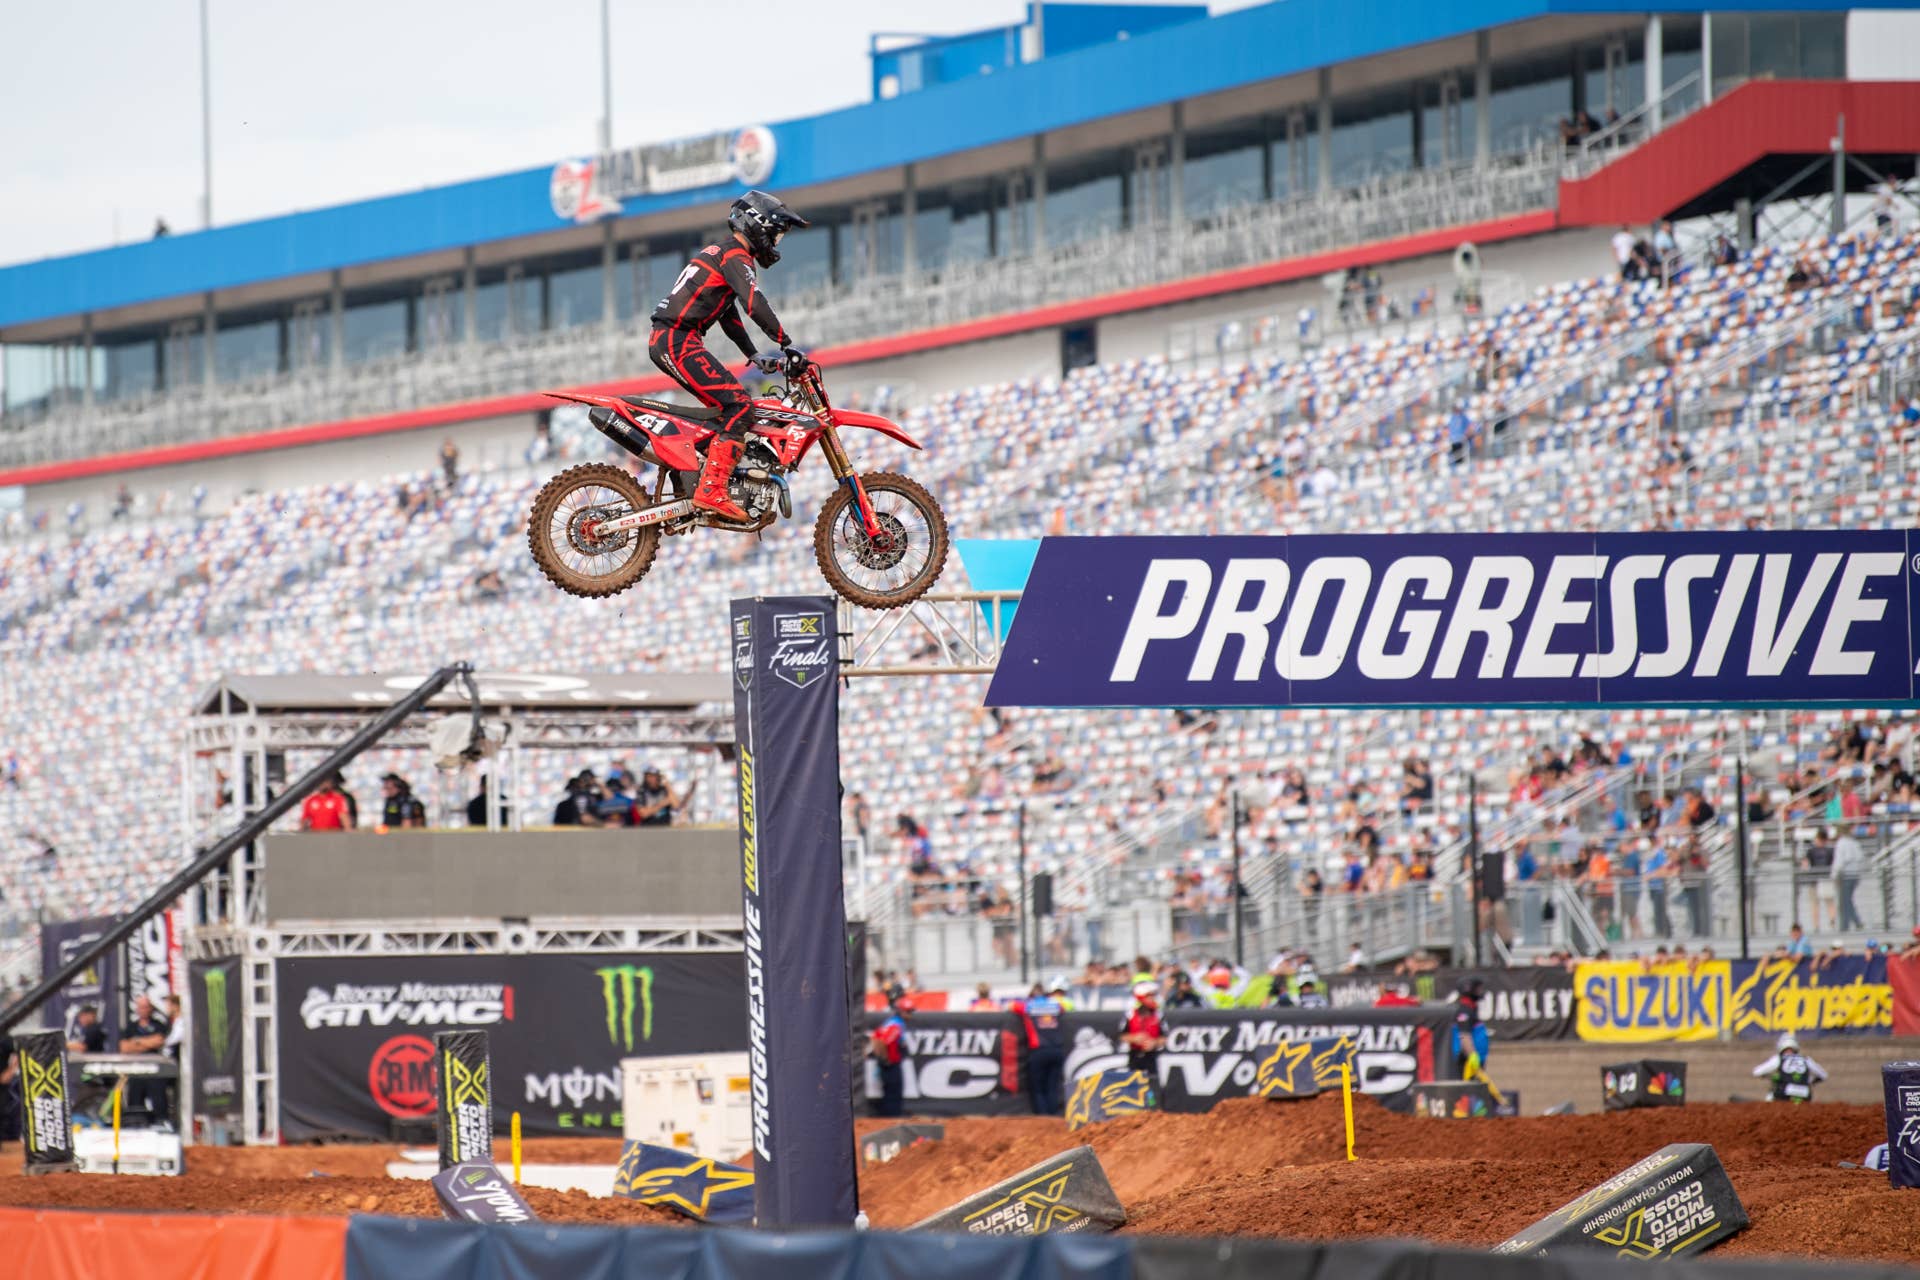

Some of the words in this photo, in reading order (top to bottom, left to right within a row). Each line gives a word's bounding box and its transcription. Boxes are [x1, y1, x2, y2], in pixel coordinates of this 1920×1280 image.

[745, 207, 774, 231] FLY
[694, 355, 722, 378] FLY
[634, 414, 670, 435] 41
[1109, 552, 1906, 682] PROGRESSIVE
[768, 639, 830, 670] Finals
[741, 743, 757, 893] HOLESHOT
[333, 983, 398, 1002] ROCKY
[400, 982, 504, 1002] MOUNTAIN
[1586, 974, 1724, 1030] SUZUKI
[745, 898, 772, 1162] PROGRESSIVE
[1166, 1025, 1234, 1051] CKY
[457, 1103, 472, 1162] SUPER
[469, 1103, 481, 1157] MOTO
[1658, 1165, 1694, 1190] WORLD
[968, 1201, 1027, 1233] SUPER
[1582, 1185, 1657, 1234] CHAMPIONSHIP
[1643, 1180, 1704, 1224] CROSS
[1650, 1195, 1706, 1236] MOTO
[1651, 1204, 1717, 1250] SUPER
